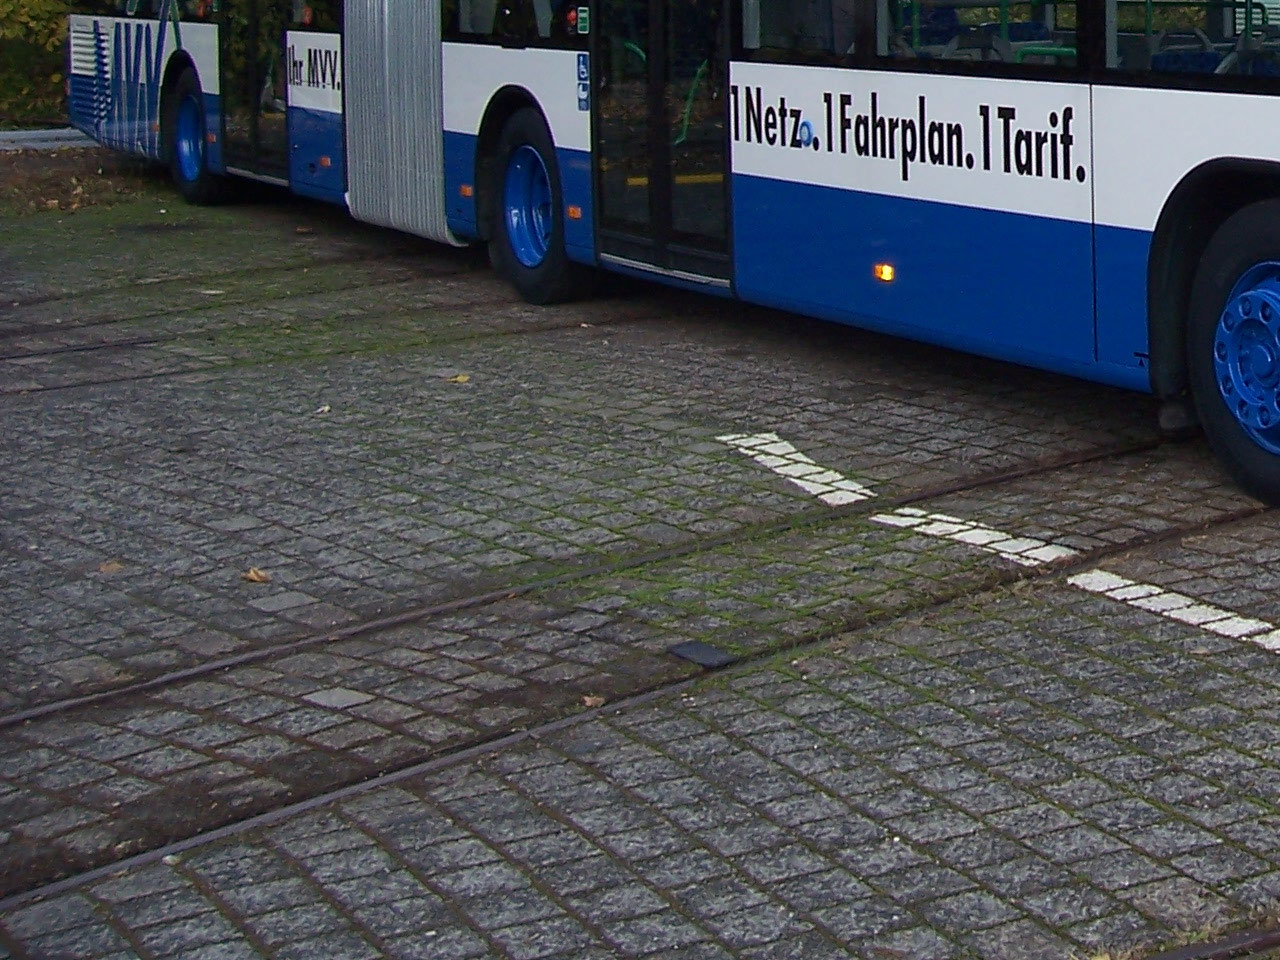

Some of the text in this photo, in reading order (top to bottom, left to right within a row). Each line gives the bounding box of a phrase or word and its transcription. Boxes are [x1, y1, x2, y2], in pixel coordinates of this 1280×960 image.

[731, 85, 740, 141] 1
[824, 93, 832, 152] 1
[840, 92, 974, 181] Fahrplan.
[980, 105, 990, 170] 1
[998, 107, 1085, 182] Tarif.
